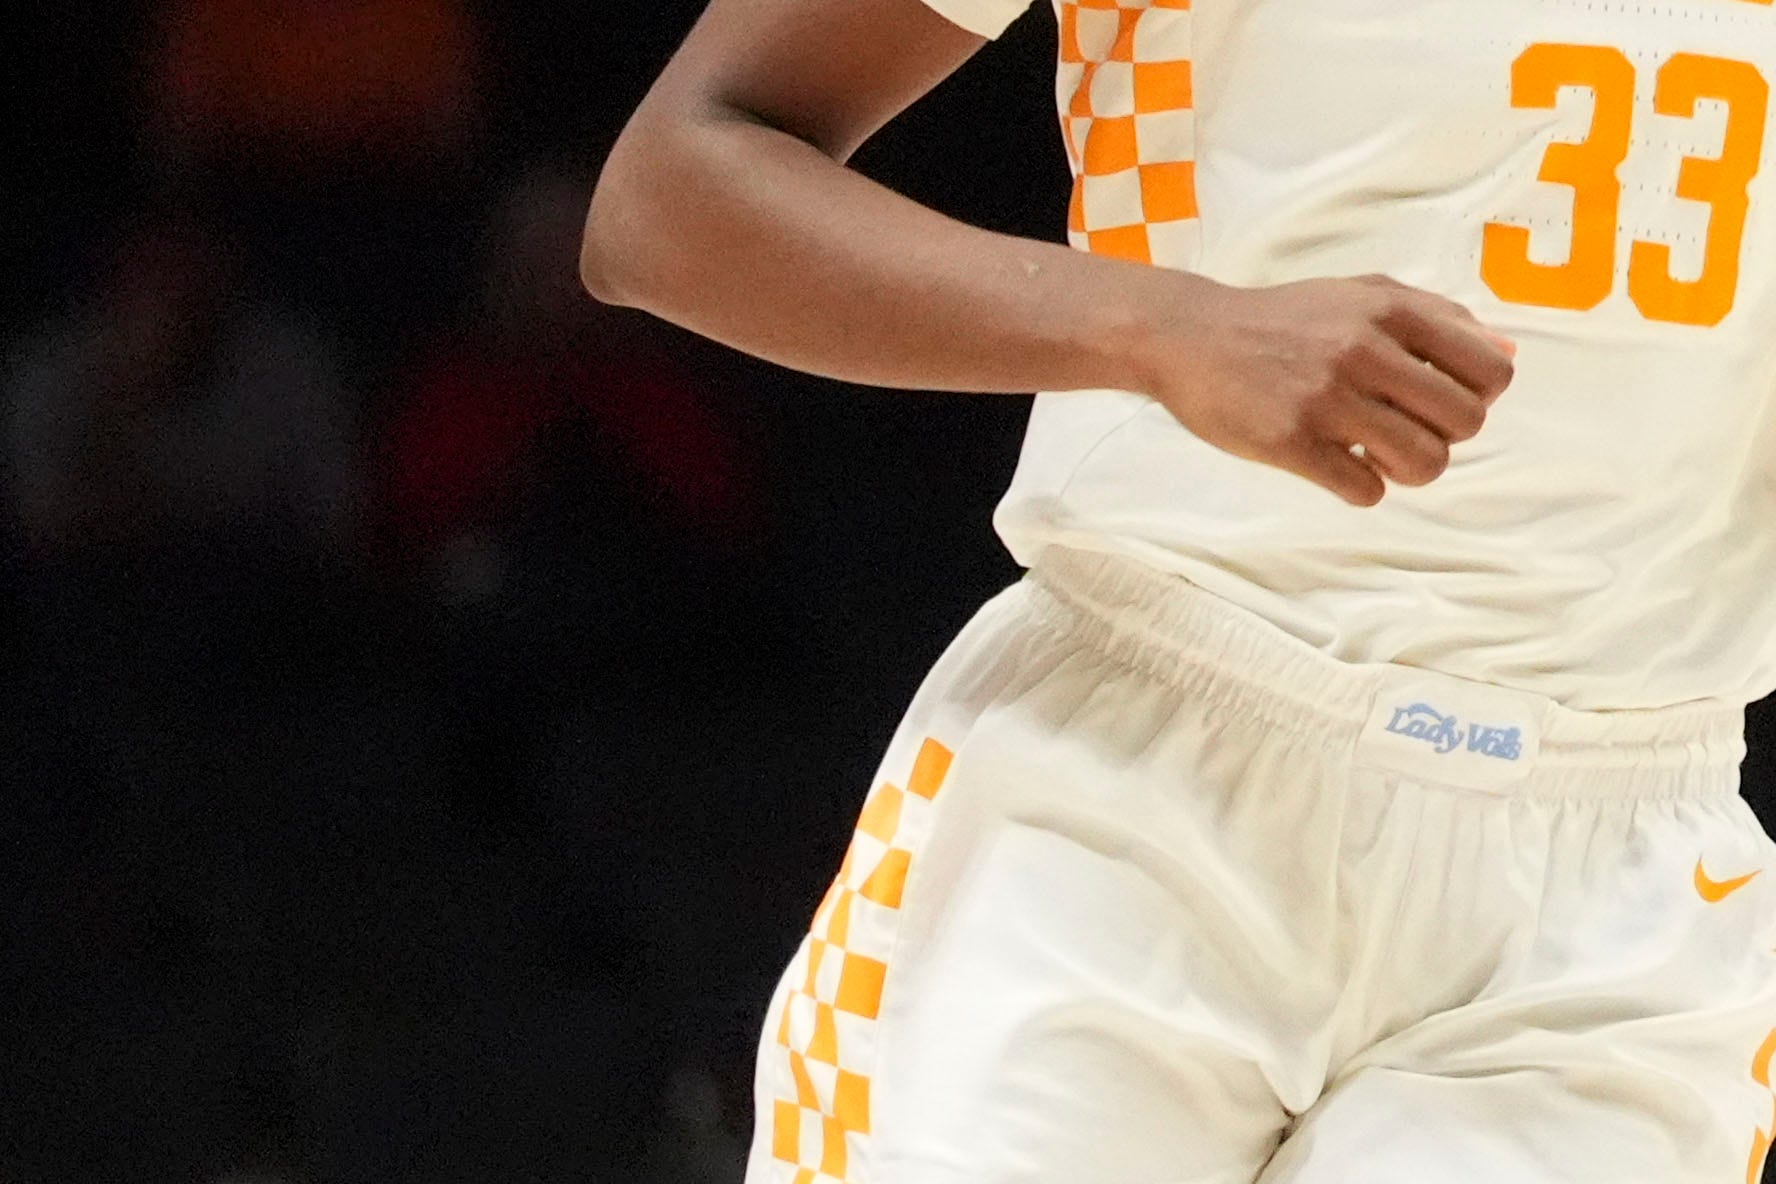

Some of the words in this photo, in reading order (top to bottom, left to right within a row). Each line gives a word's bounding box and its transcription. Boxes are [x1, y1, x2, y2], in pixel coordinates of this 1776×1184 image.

[1480, 42, 1769, 327] 33
[1384, 702, 1465, 754] Lady
[1466, 722, 1522, 761] Vols
